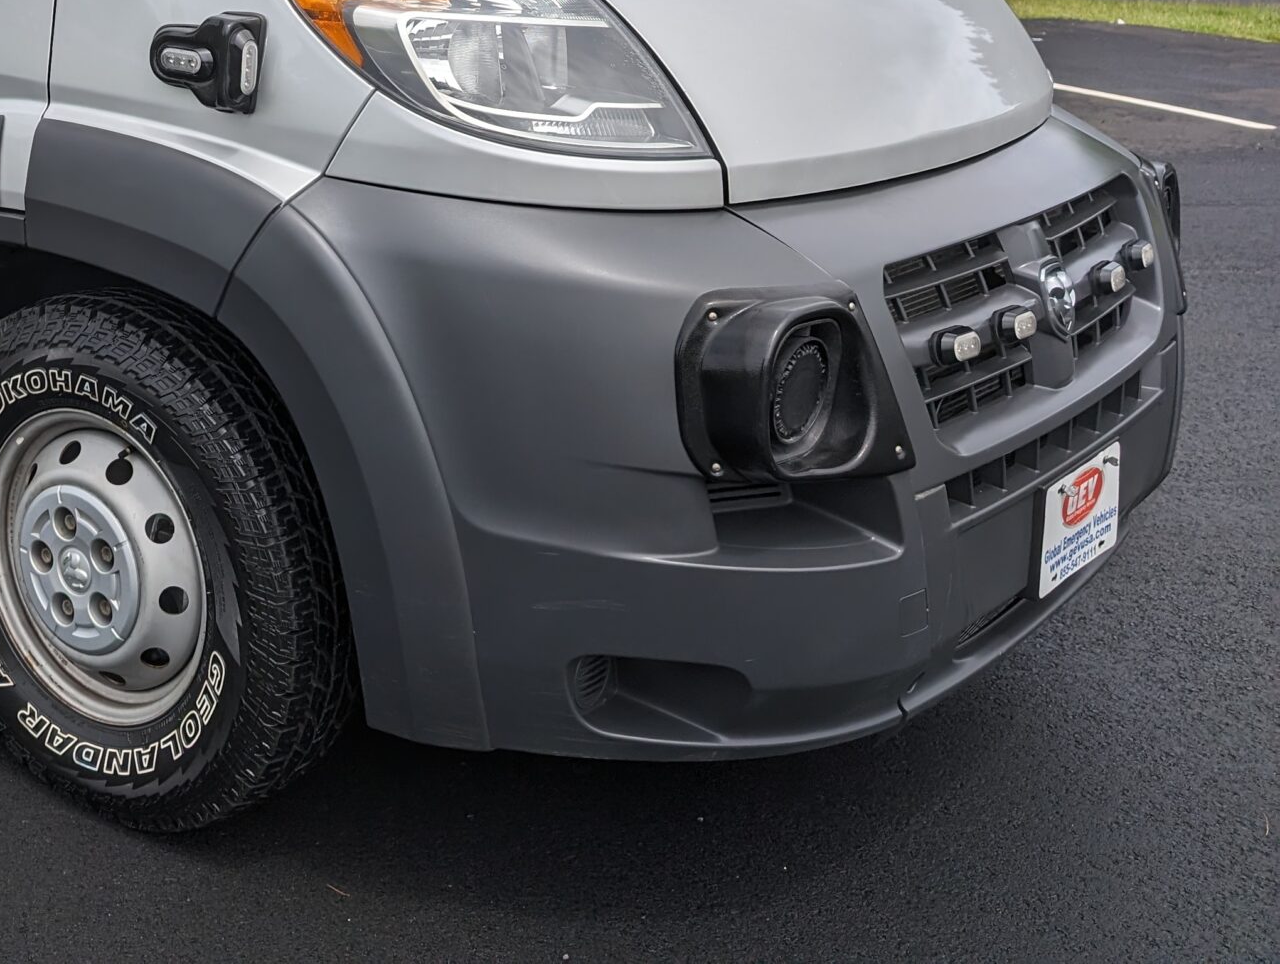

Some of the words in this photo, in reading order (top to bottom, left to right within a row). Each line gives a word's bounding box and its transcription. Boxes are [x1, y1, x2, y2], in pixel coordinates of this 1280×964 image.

[1044, 540, 1063, 564] Global
[1062, 524, 1092, 551] Emergency
[1093, 506, 1117, 529] Vehicles
[1049, 522, 1112, 573] www.gevusa.com
[1059, 545, 1097, 580] 855-547-9111
[17, 649, 226, 777] GEOLANDAR
